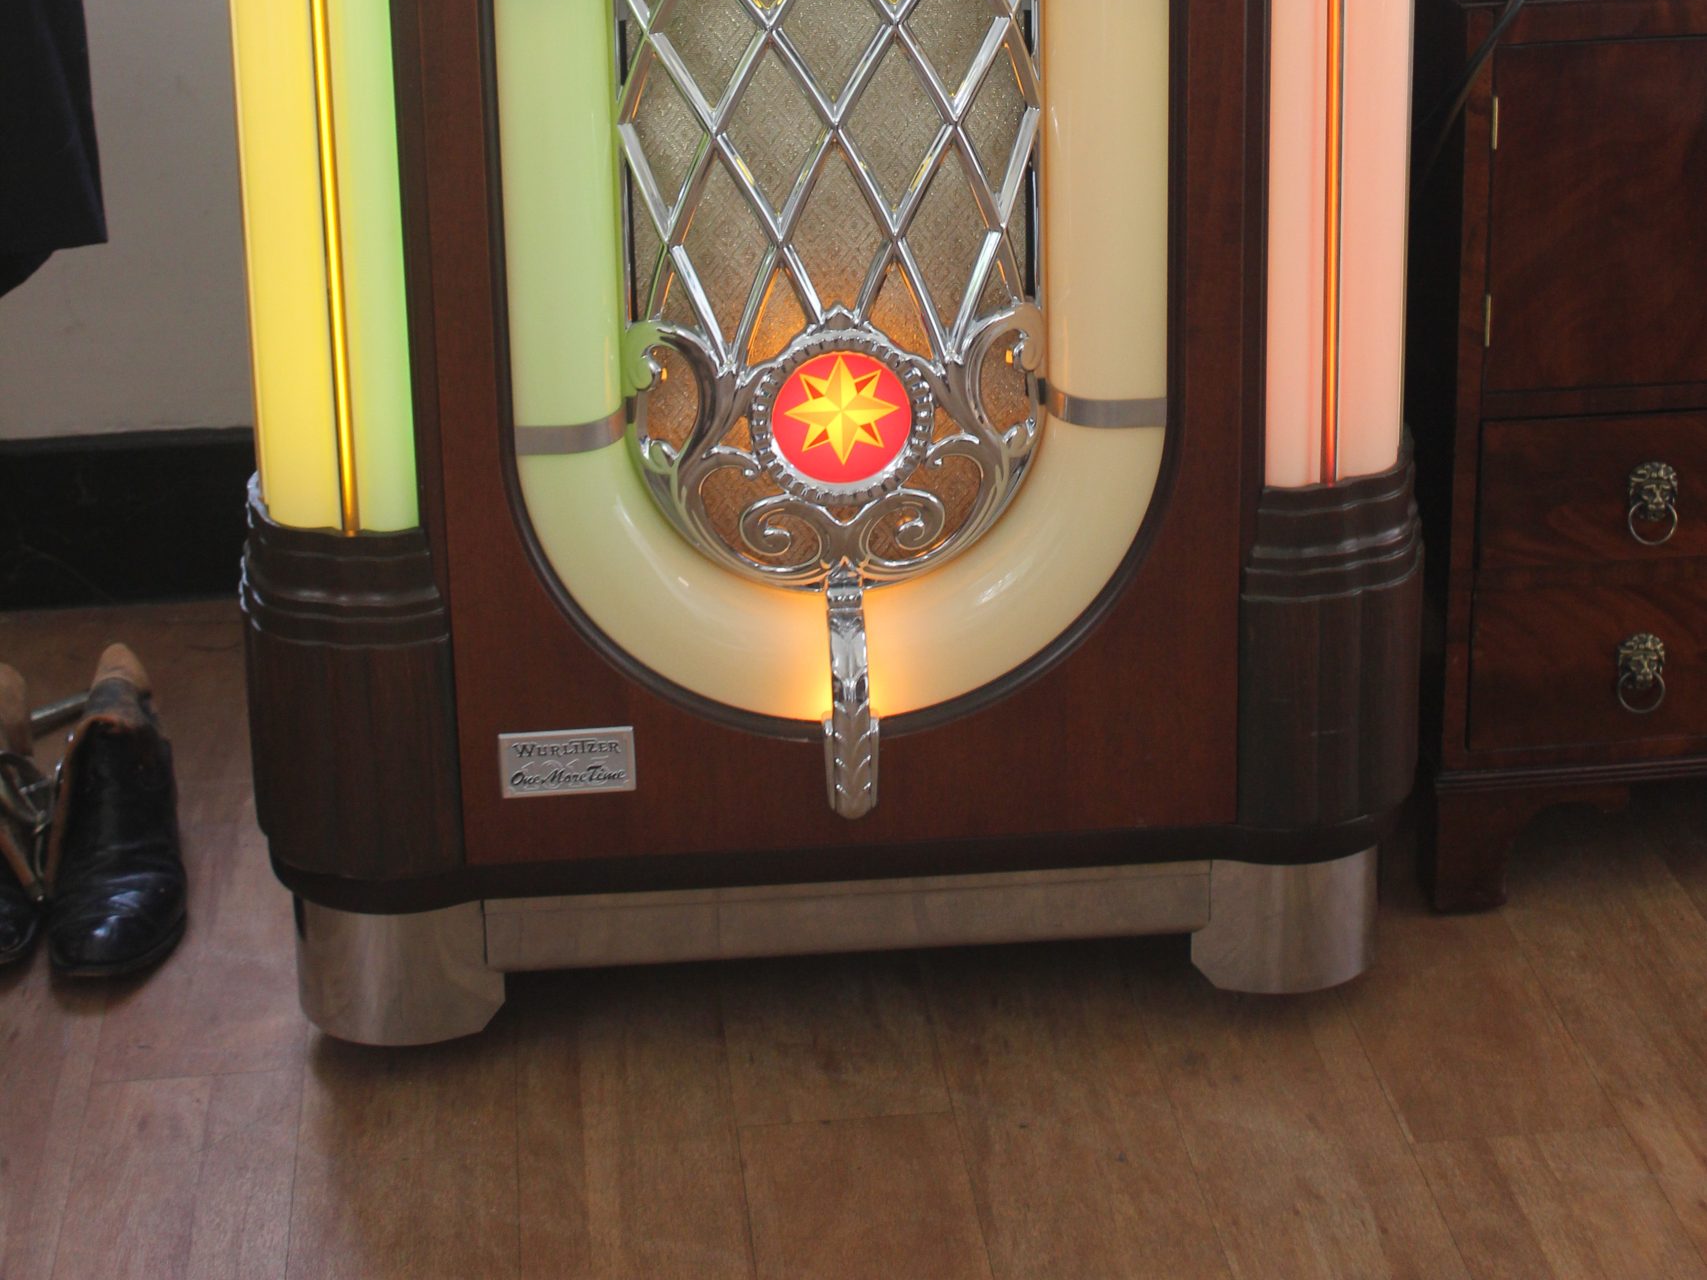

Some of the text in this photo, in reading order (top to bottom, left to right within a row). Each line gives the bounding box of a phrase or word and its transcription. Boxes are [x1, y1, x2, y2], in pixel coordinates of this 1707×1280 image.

[512, 738, 621, 758] WURLITZER
[511, 765, 625, 786] One More Time
